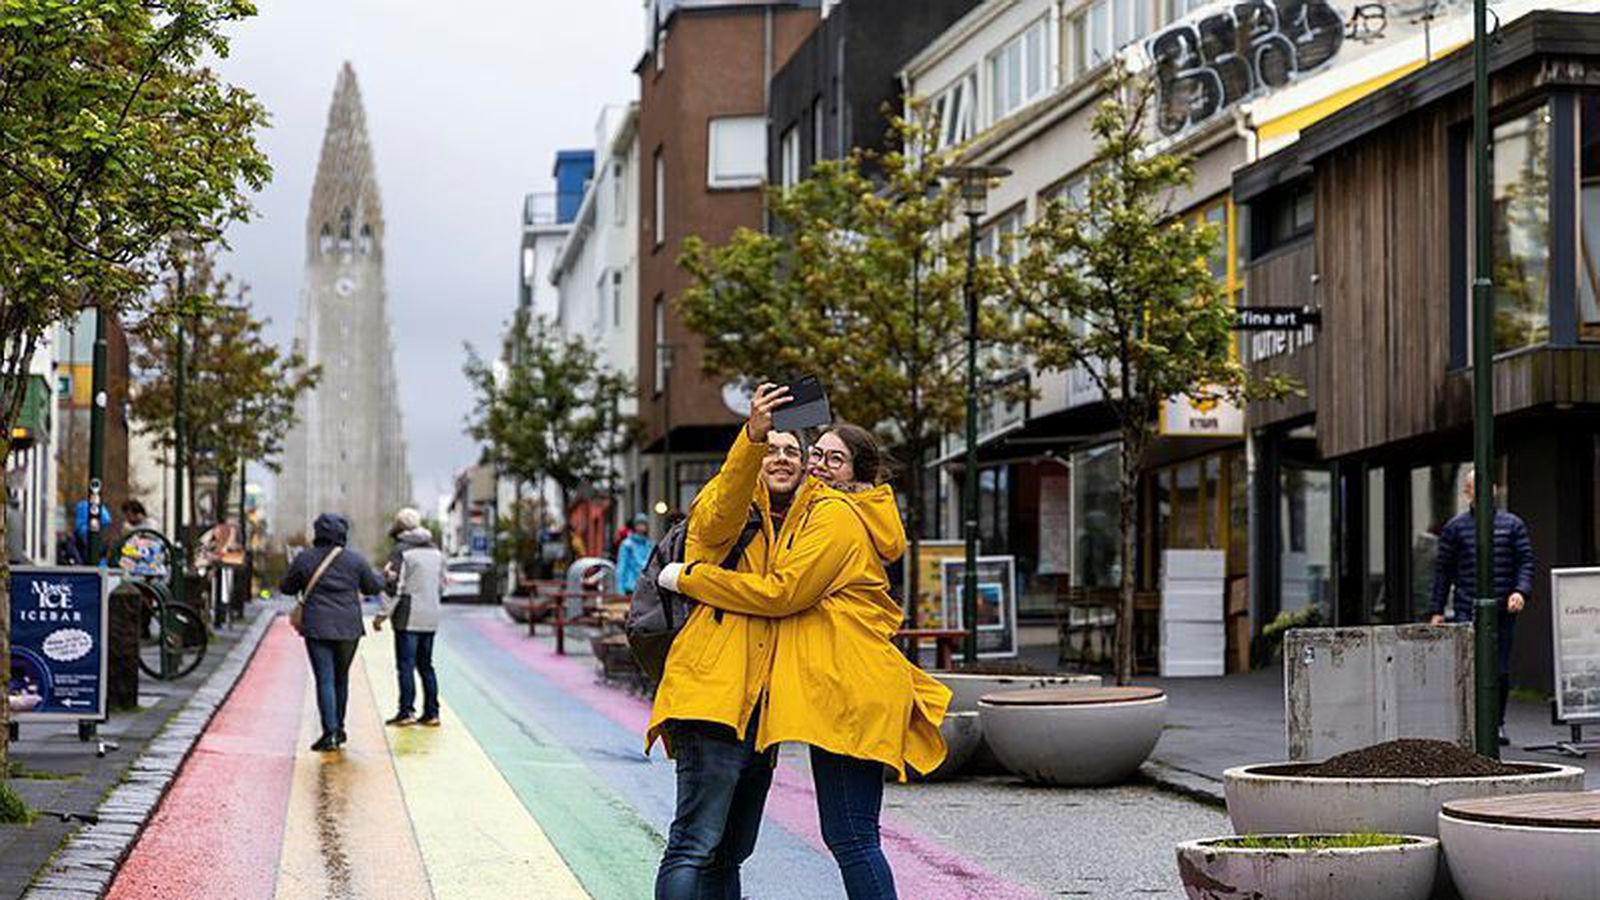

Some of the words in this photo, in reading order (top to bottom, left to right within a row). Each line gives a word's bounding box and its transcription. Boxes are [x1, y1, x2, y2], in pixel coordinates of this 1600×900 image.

[1242, 311, 1271, 325] fine
[1274, 312, 1298, 325] art
[38, 594, 73, 609] ICE
[20, 610, 81, 621] ICEBAR
